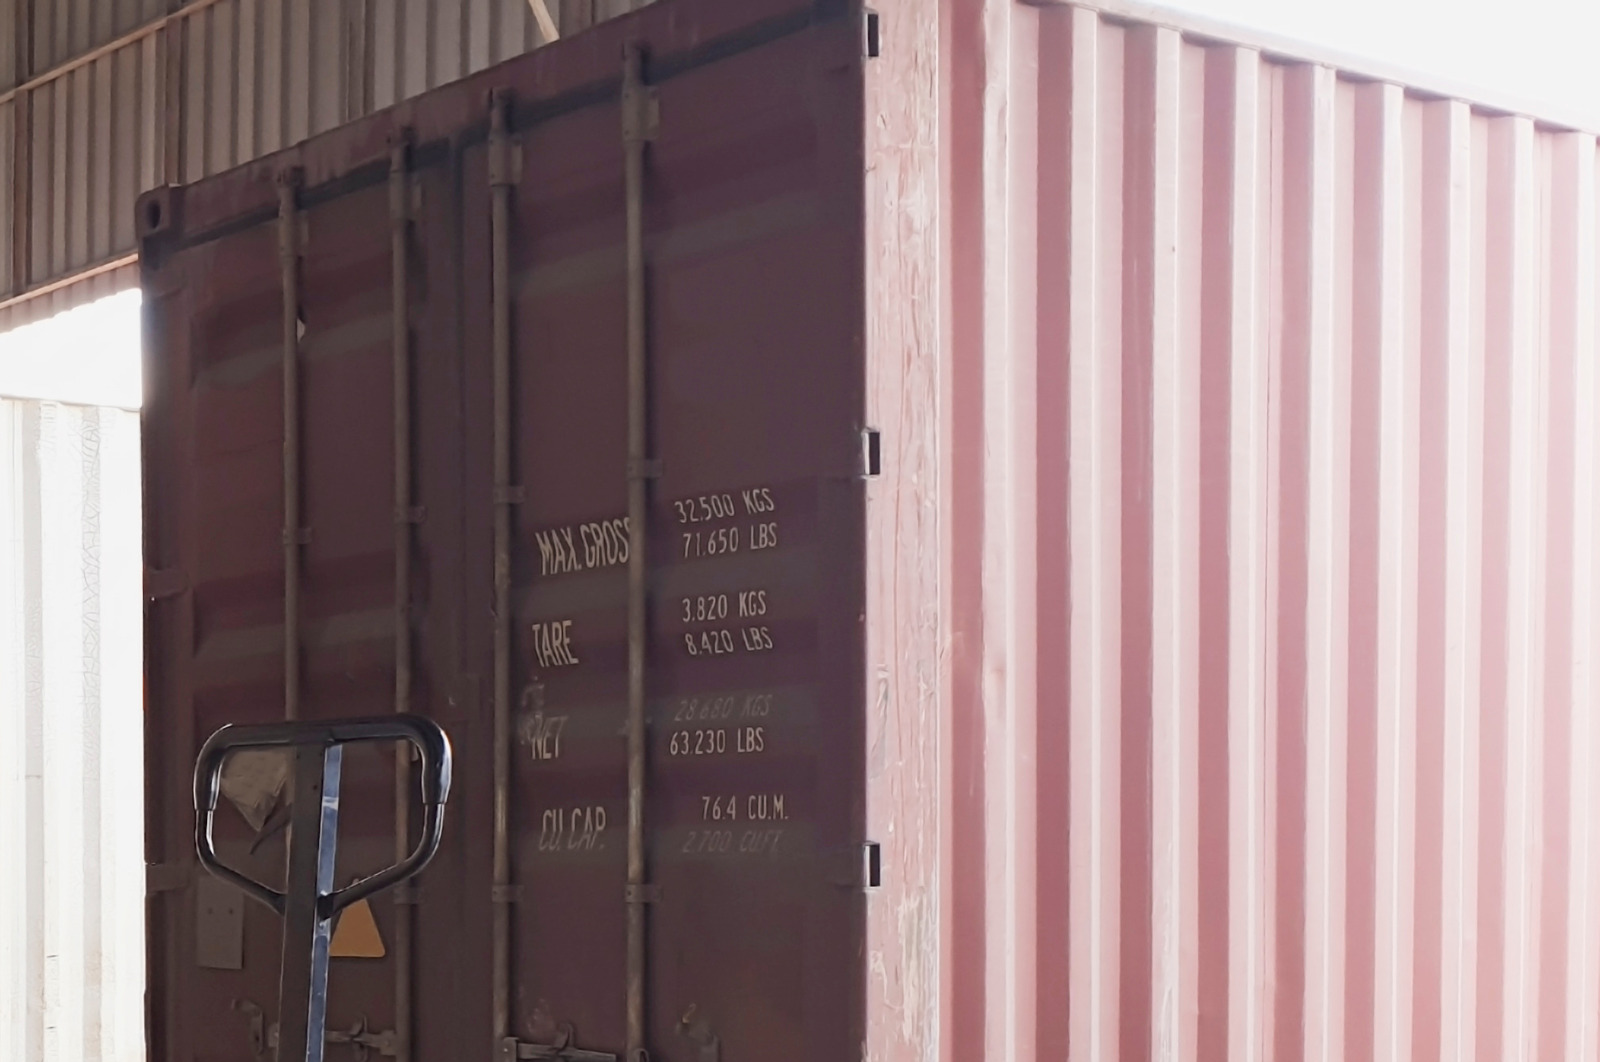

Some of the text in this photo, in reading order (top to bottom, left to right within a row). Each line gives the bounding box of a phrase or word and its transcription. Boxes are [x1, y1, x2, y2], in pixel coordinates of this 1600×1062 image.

[675, 488, 775, 523] 32.500 KGS
[534, 525, 582, 576] MAX.
[683, 522, 778, 558] 71.650 LBS
[682, 590, 767, 622] 3.820 KGS
[532, 620, 579, 667] TARE
[685, 627, 773, 656] 8.420 LBS
[527, 711, 569, 760] NET
[669, 726, 765, 756] 63.230 LBS
[702, 794, 736, 821] 76.4
